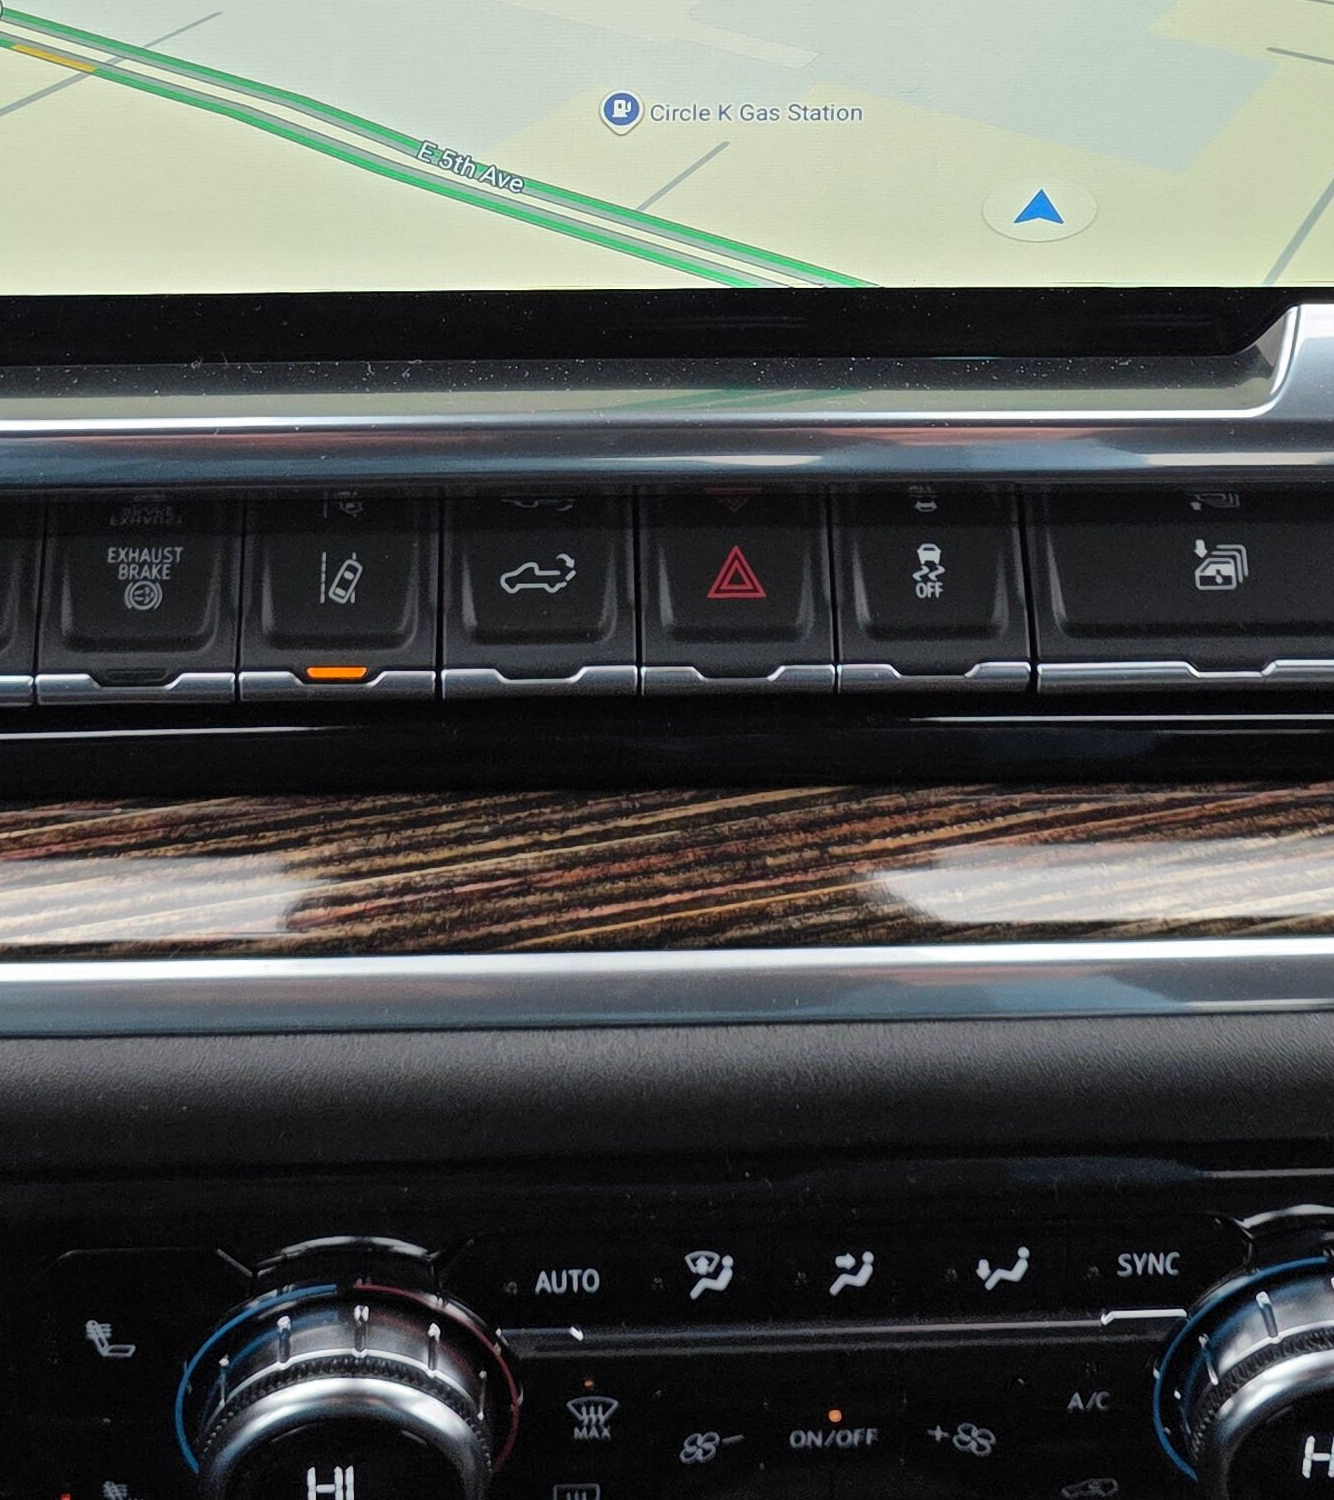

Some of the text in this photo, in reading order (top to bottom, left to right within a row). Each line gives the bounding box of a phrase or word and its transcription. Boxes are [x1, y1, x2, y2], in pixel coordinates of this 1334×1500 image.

[650, 102, 864, 124] Circle K Gas Station
[417, 141, 525, 195] E 5th Ave
[107, 546, 185, 564] EXHAUST
[117, 563, 172, 580] BRAKE
[915, 581, 944, 599] OFF
[1116, 1251, 1181, 1277] SYNC
[535, 1268, 600, 1295] AUTO
[1067, 1390, 1110, 1412] A/C
[574, 1426, 612, 1440] MAX
[789, 1429, 880, 1450] ON/OFF
[305, 1465, 355, 1500] HI
